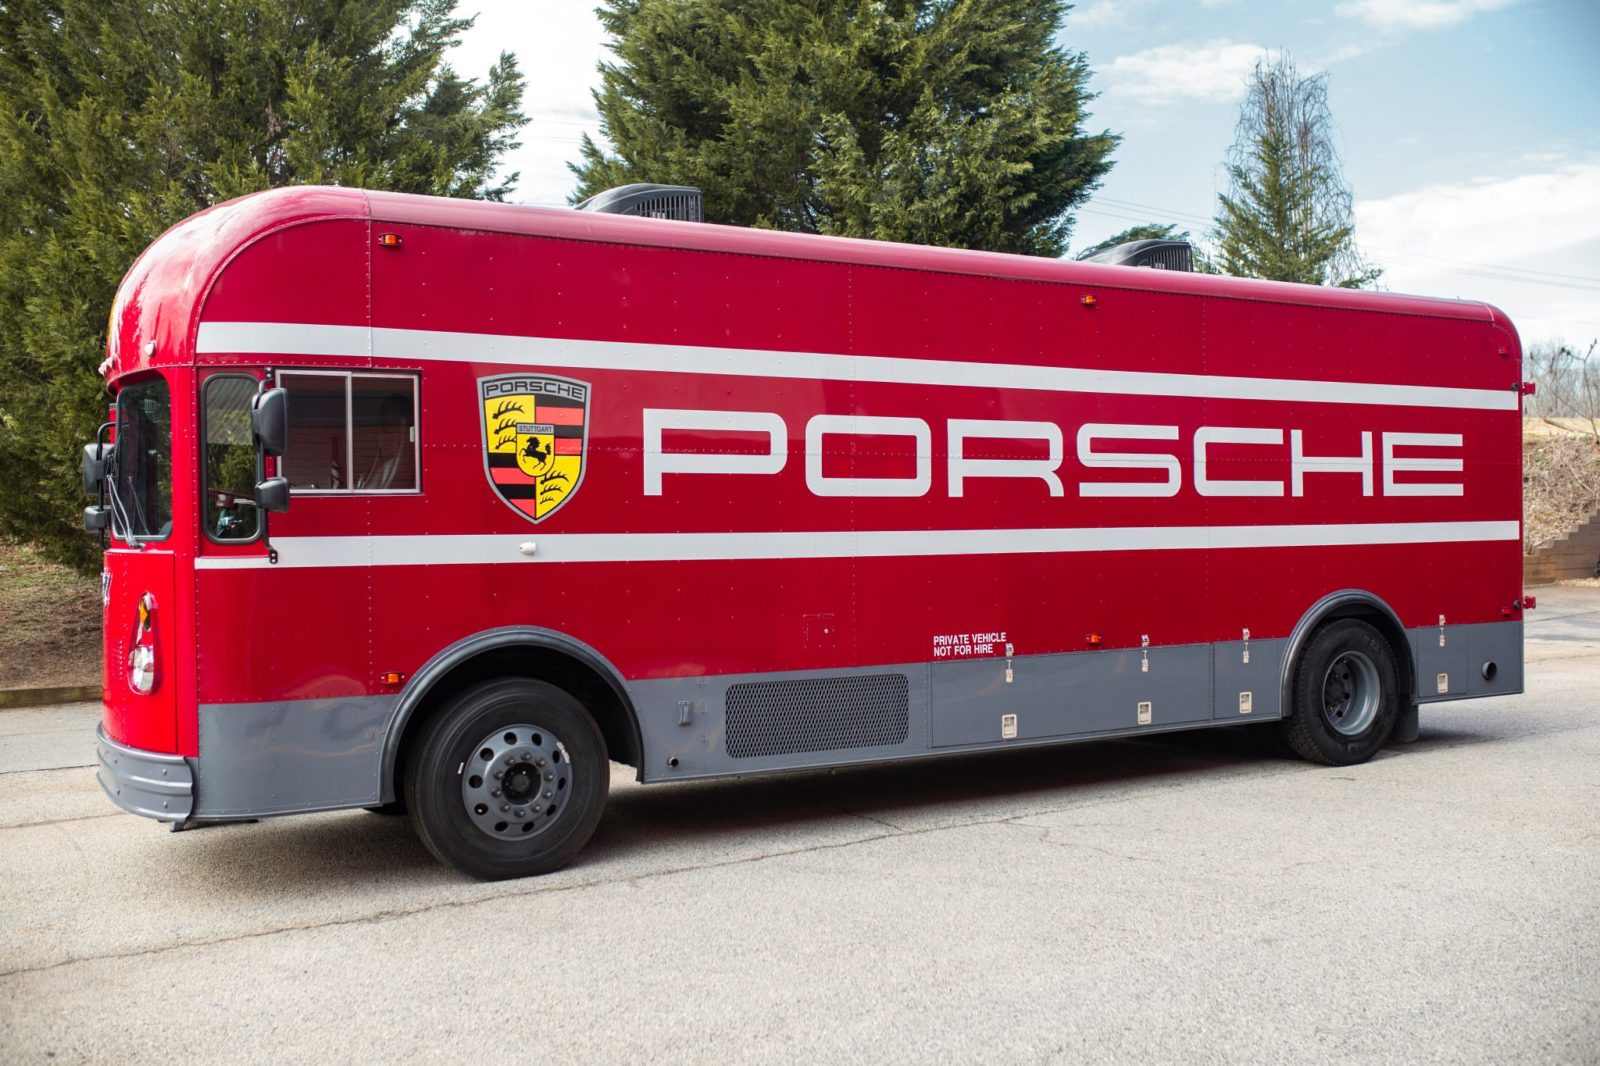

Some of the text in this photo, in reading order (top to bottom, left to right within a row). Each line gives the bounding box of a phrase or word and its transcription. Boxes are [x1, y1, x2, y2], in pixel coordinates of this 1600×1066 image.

[486, 381, 583, 400] PORSCHE
[519, 425, 553, 433] STUTTGART
[643, 408, 1463, 497] PORSCHE
[933, 632, 1007, 646] PRIVATE VEHICLE
[933, 644, 993, 657] NOT FOR HIRE
